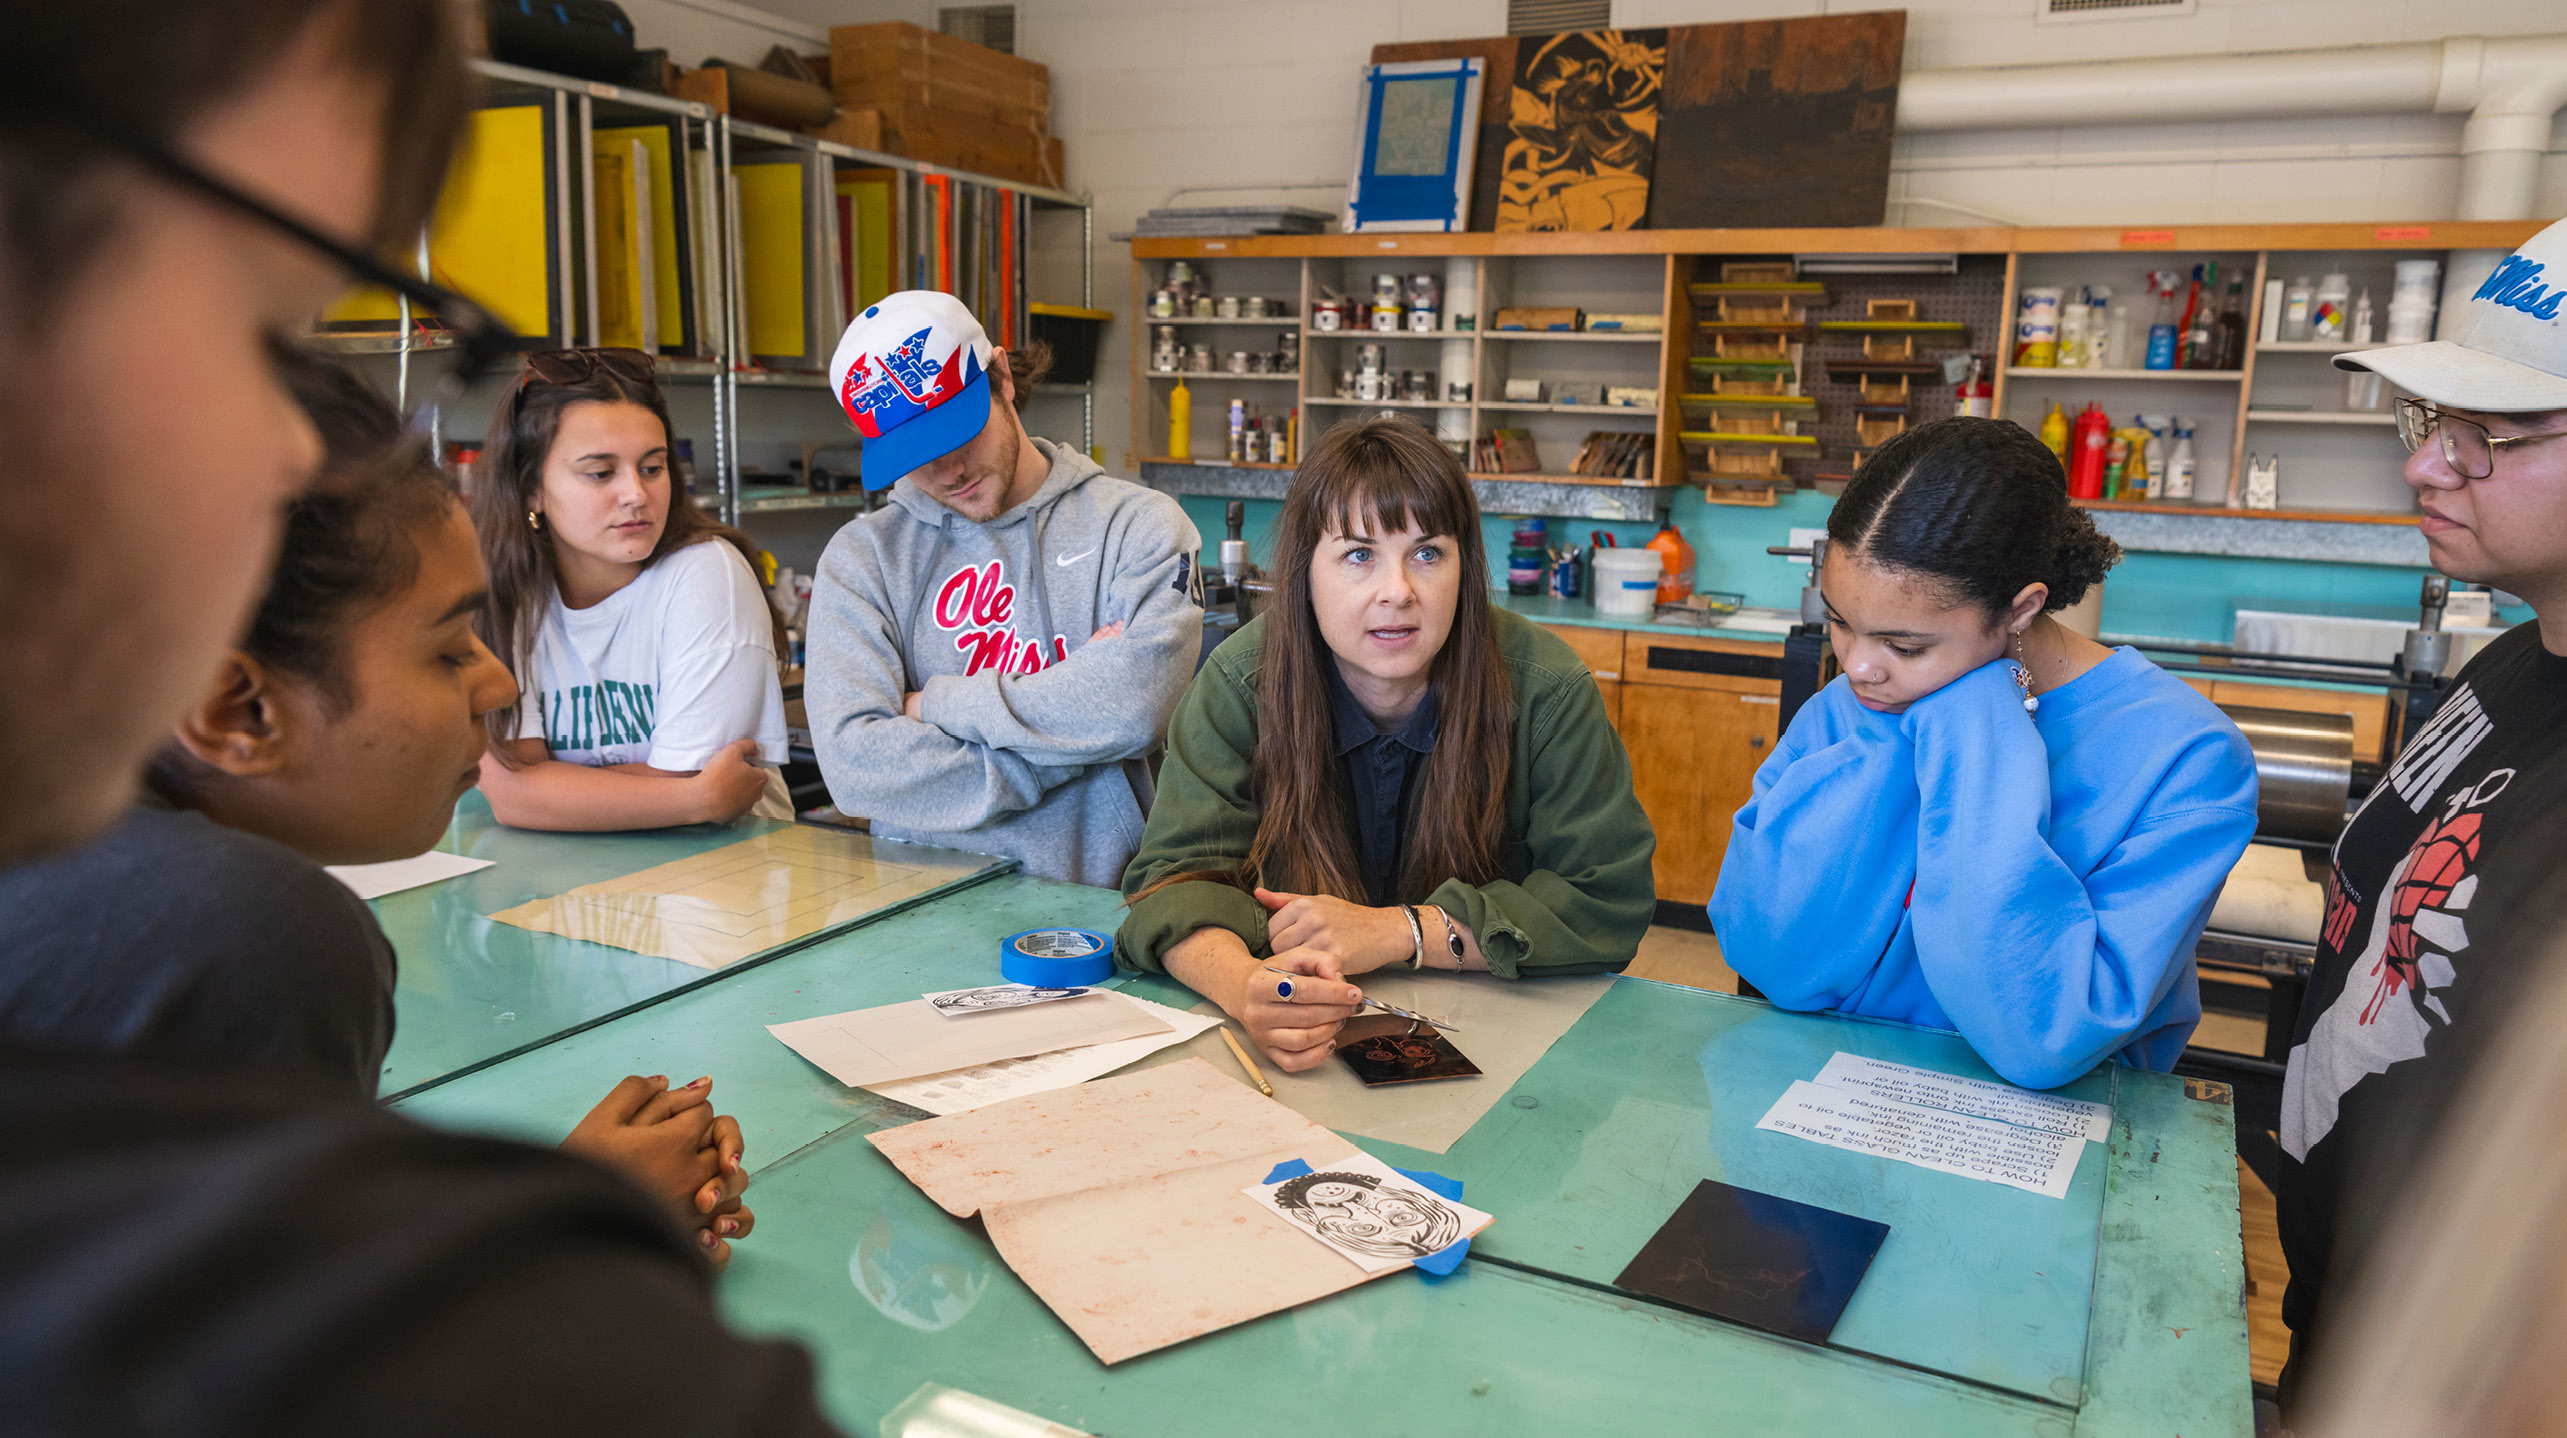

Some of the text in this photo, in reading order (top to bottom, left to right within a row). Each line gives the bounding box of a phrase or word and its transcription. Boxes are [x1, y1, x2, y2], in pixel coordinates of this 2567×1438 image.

[2471, 254, 2567, 321] Miss
[933, 559, 1017, 631] Ole
[1915, 1071, 1963, 1084] Simple
[1913, 1083, 1949, 1095] baby
[1969, 1082, 1997, 1091] with
[1916, 1091, 1949, 1101] onto
[1954, 1092, 1982, 1102] with
[1849, 1098, 1926, 1118] denatured
[1954, 1099, 1975, 1108] ink
[1930, 1116, 1960, 1126] with
[2038, 1116, 2067, 1126] Roll
[2075, 1116, 2091, 1125] 2)
[1896, 1116, 1972, 1137] remaining
[2042, 1124, 2086, 1138] HOW
[1847, 1130, 1869, 1139] ink
[1874, 1135, 1916, 1149] much
[1920, 1139, 1943, 1148] the
[1959, 1138, 1998, 1152] baby
[1774, 1120, 2046, 1186] HOW TO CLEAN GLASS TABLES
[1949, 1144, 1981, 1155] with
[2003, 1149, 2034, 1160] Use
[1970, 1157, 2028, 1173] Scrape
[1986, 1153, 2054, 1170] possible
[2040, 1155, 2056, 1164] 2)
